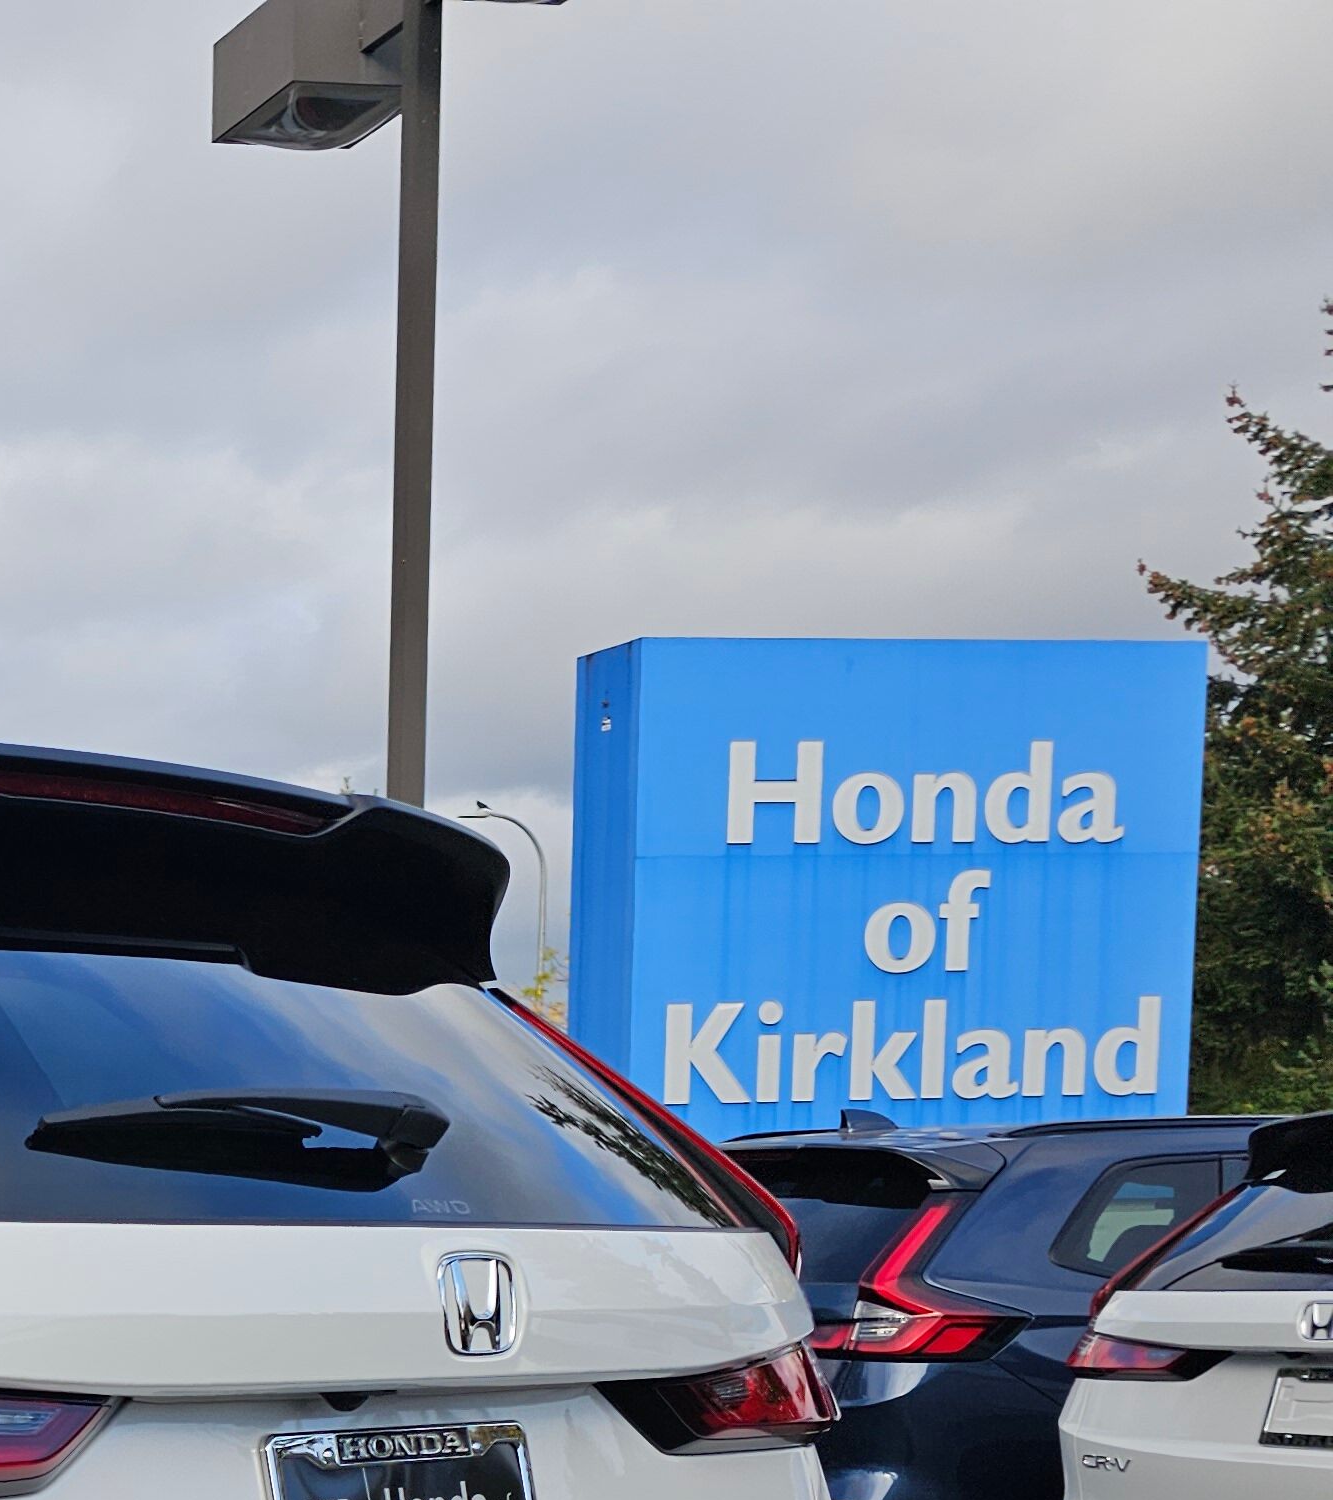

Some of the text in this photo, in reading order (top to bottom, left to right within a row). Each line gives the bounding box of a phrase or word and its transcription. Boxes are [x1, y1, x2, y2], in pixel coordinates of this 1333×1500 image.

[726, 740, 1125, 845] Honda
[864, 870, 991, 974] of
[663, 996, 1162, 1105] Kirkland
[339, 1431, 469, 1461] HONDA
[1082, 1454, 1131, 1472] CR-V
